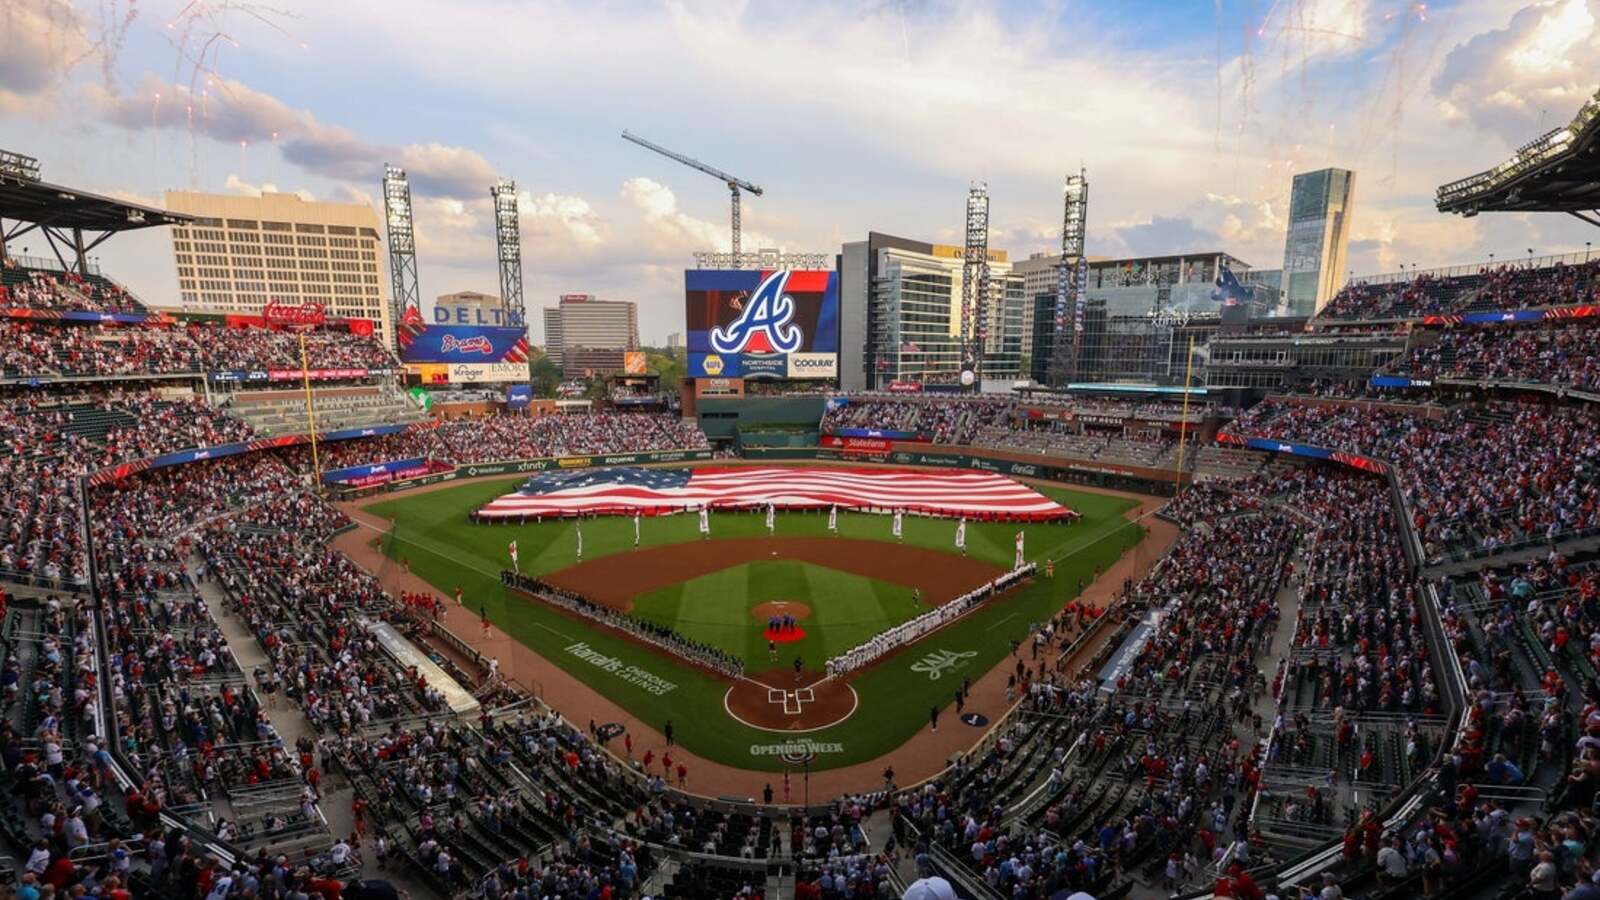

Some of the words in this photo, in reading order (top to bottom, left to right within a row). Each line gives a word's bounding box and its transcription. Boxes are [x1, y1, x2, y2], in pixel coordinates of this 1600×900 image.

[433, 306, 525, 325] DELTA
[712, 269, 802, 353] A
[1151, 316, 1189, 328] xfinity
[441, 334, 492, 354] Braves
[794, 358, 834, 368] COOLRAY
[454, 366, 483, 379] Kroger
[1099, 417, 1123, 425] HOUSE
[517, 461, 548, 472] xfinity
[615, 669, 665, 695] CASINOS
[750, 744, 807, 756] OPENING
[807, 742, 844, 753] WEEK
